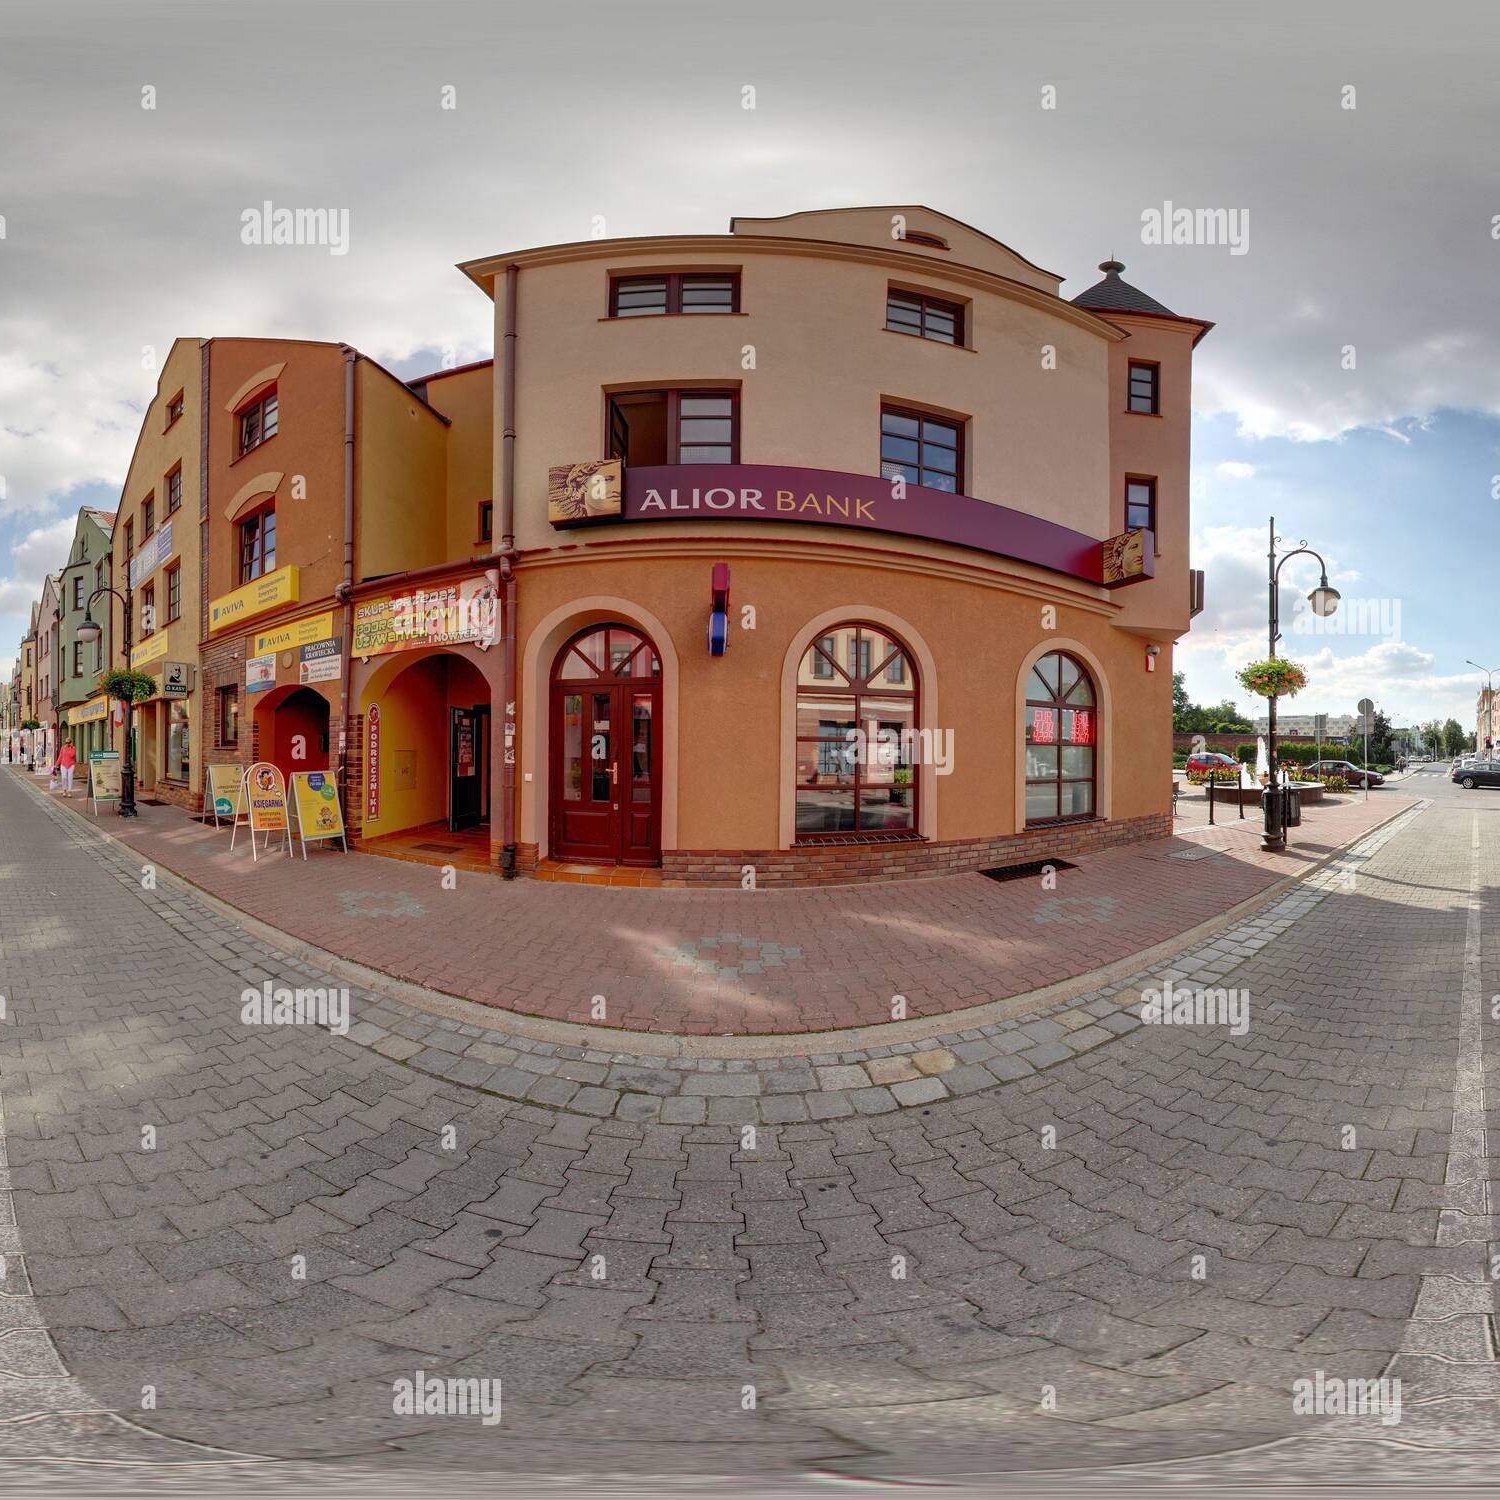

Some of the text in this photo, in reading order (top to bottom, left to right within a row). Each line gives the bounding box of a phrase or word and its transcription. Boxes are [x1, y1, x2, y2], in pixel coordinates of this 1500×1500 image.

[640, 488, 876, 520] ALIOR BANK
[221, 599, 245, 617] AVIVA
[266, 632, 291, 647] AVIVA
[304, 640, 336, 653] PRACOWNIA
[305, 648, 336, 660] KRAWIECKA
[370, 724, 378, 814] PODRĘCZNIKI
[254, 799, 283, 810] KSIĘGARNIA
